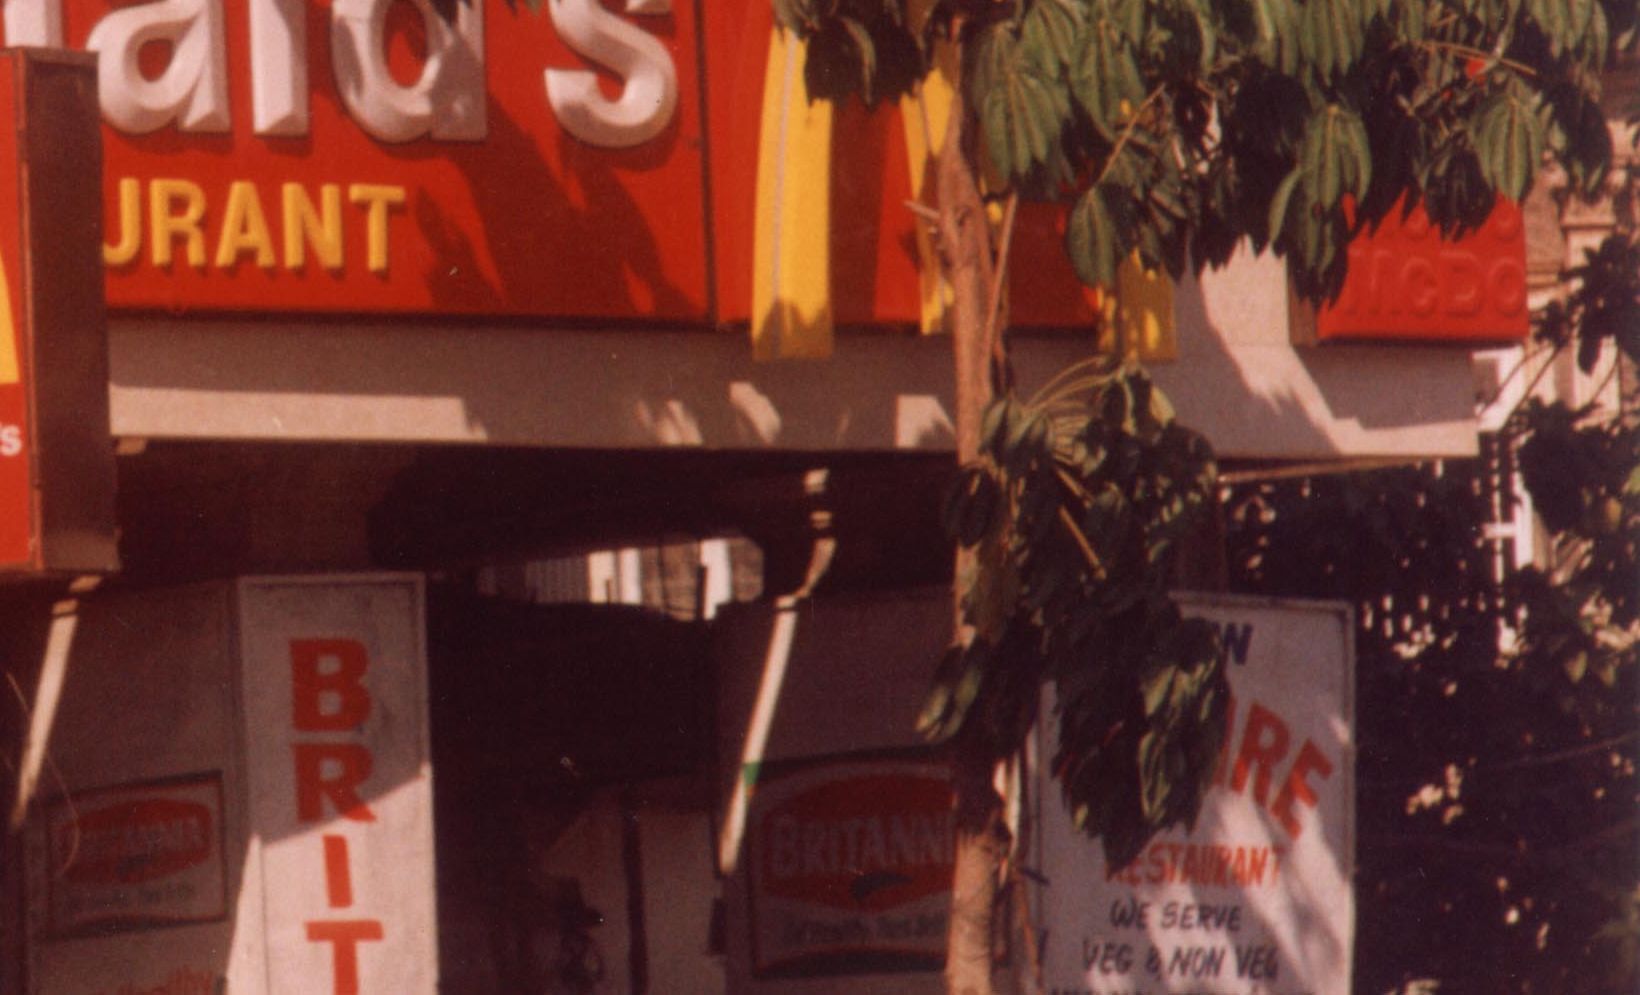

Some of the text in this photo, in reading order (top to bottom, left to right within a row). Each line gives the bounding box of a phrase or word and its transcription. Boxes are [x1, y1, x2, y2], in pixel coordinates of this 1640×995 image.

[1109, 895, 1242, 933] WE SERVE
[1082, 940, 1136, 975] VEG
[1168, 945, 1226, 978] NON
[1236, 946, 1281, 981] VEG
